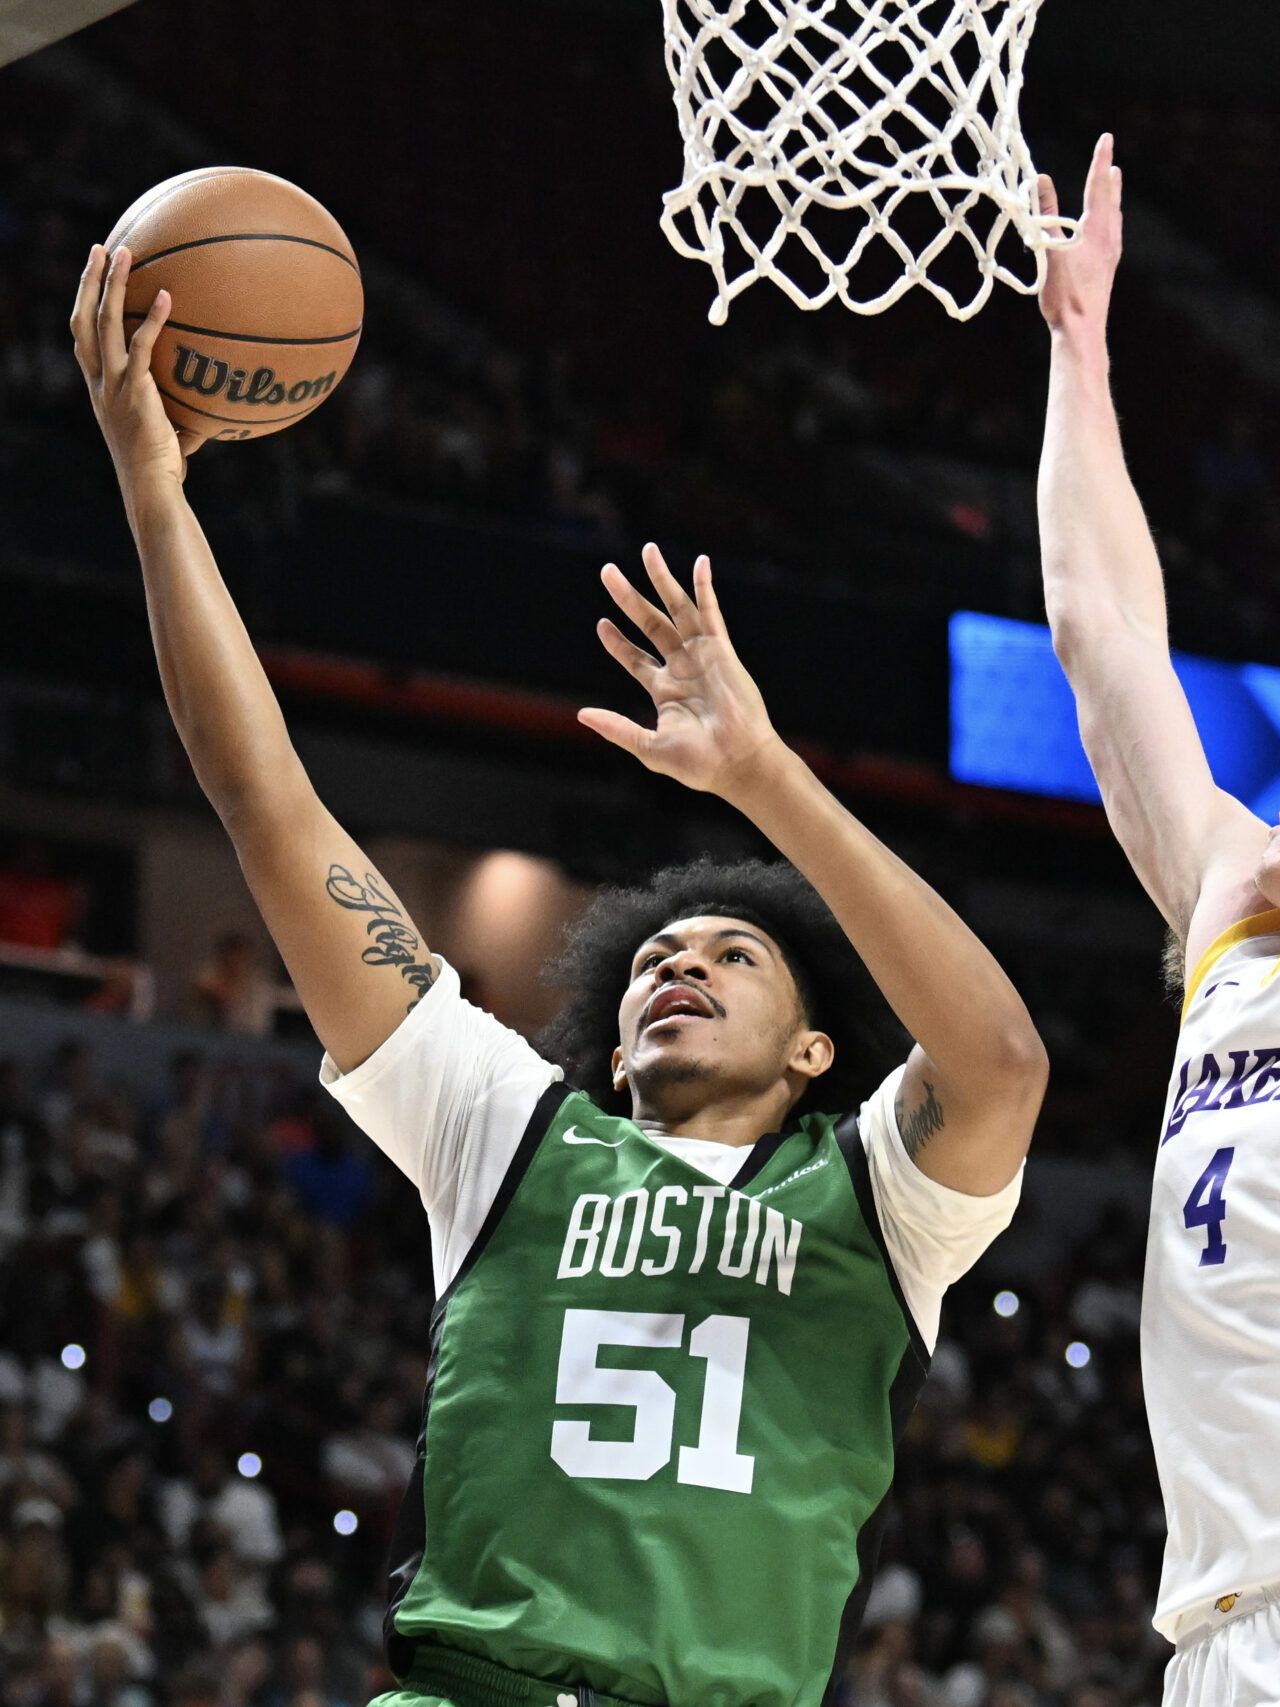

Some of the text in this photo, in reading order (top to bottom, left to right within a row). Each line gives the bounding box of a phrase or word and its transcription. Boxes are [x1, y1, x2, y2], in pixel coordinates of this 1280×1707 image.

[174, 344, 337, 405] Wilson
[556, 1185, 803, 1296] BOSTON
[1183, 1146, 1235, 1267] 4
[550, 1308, 755, 1494] 51
